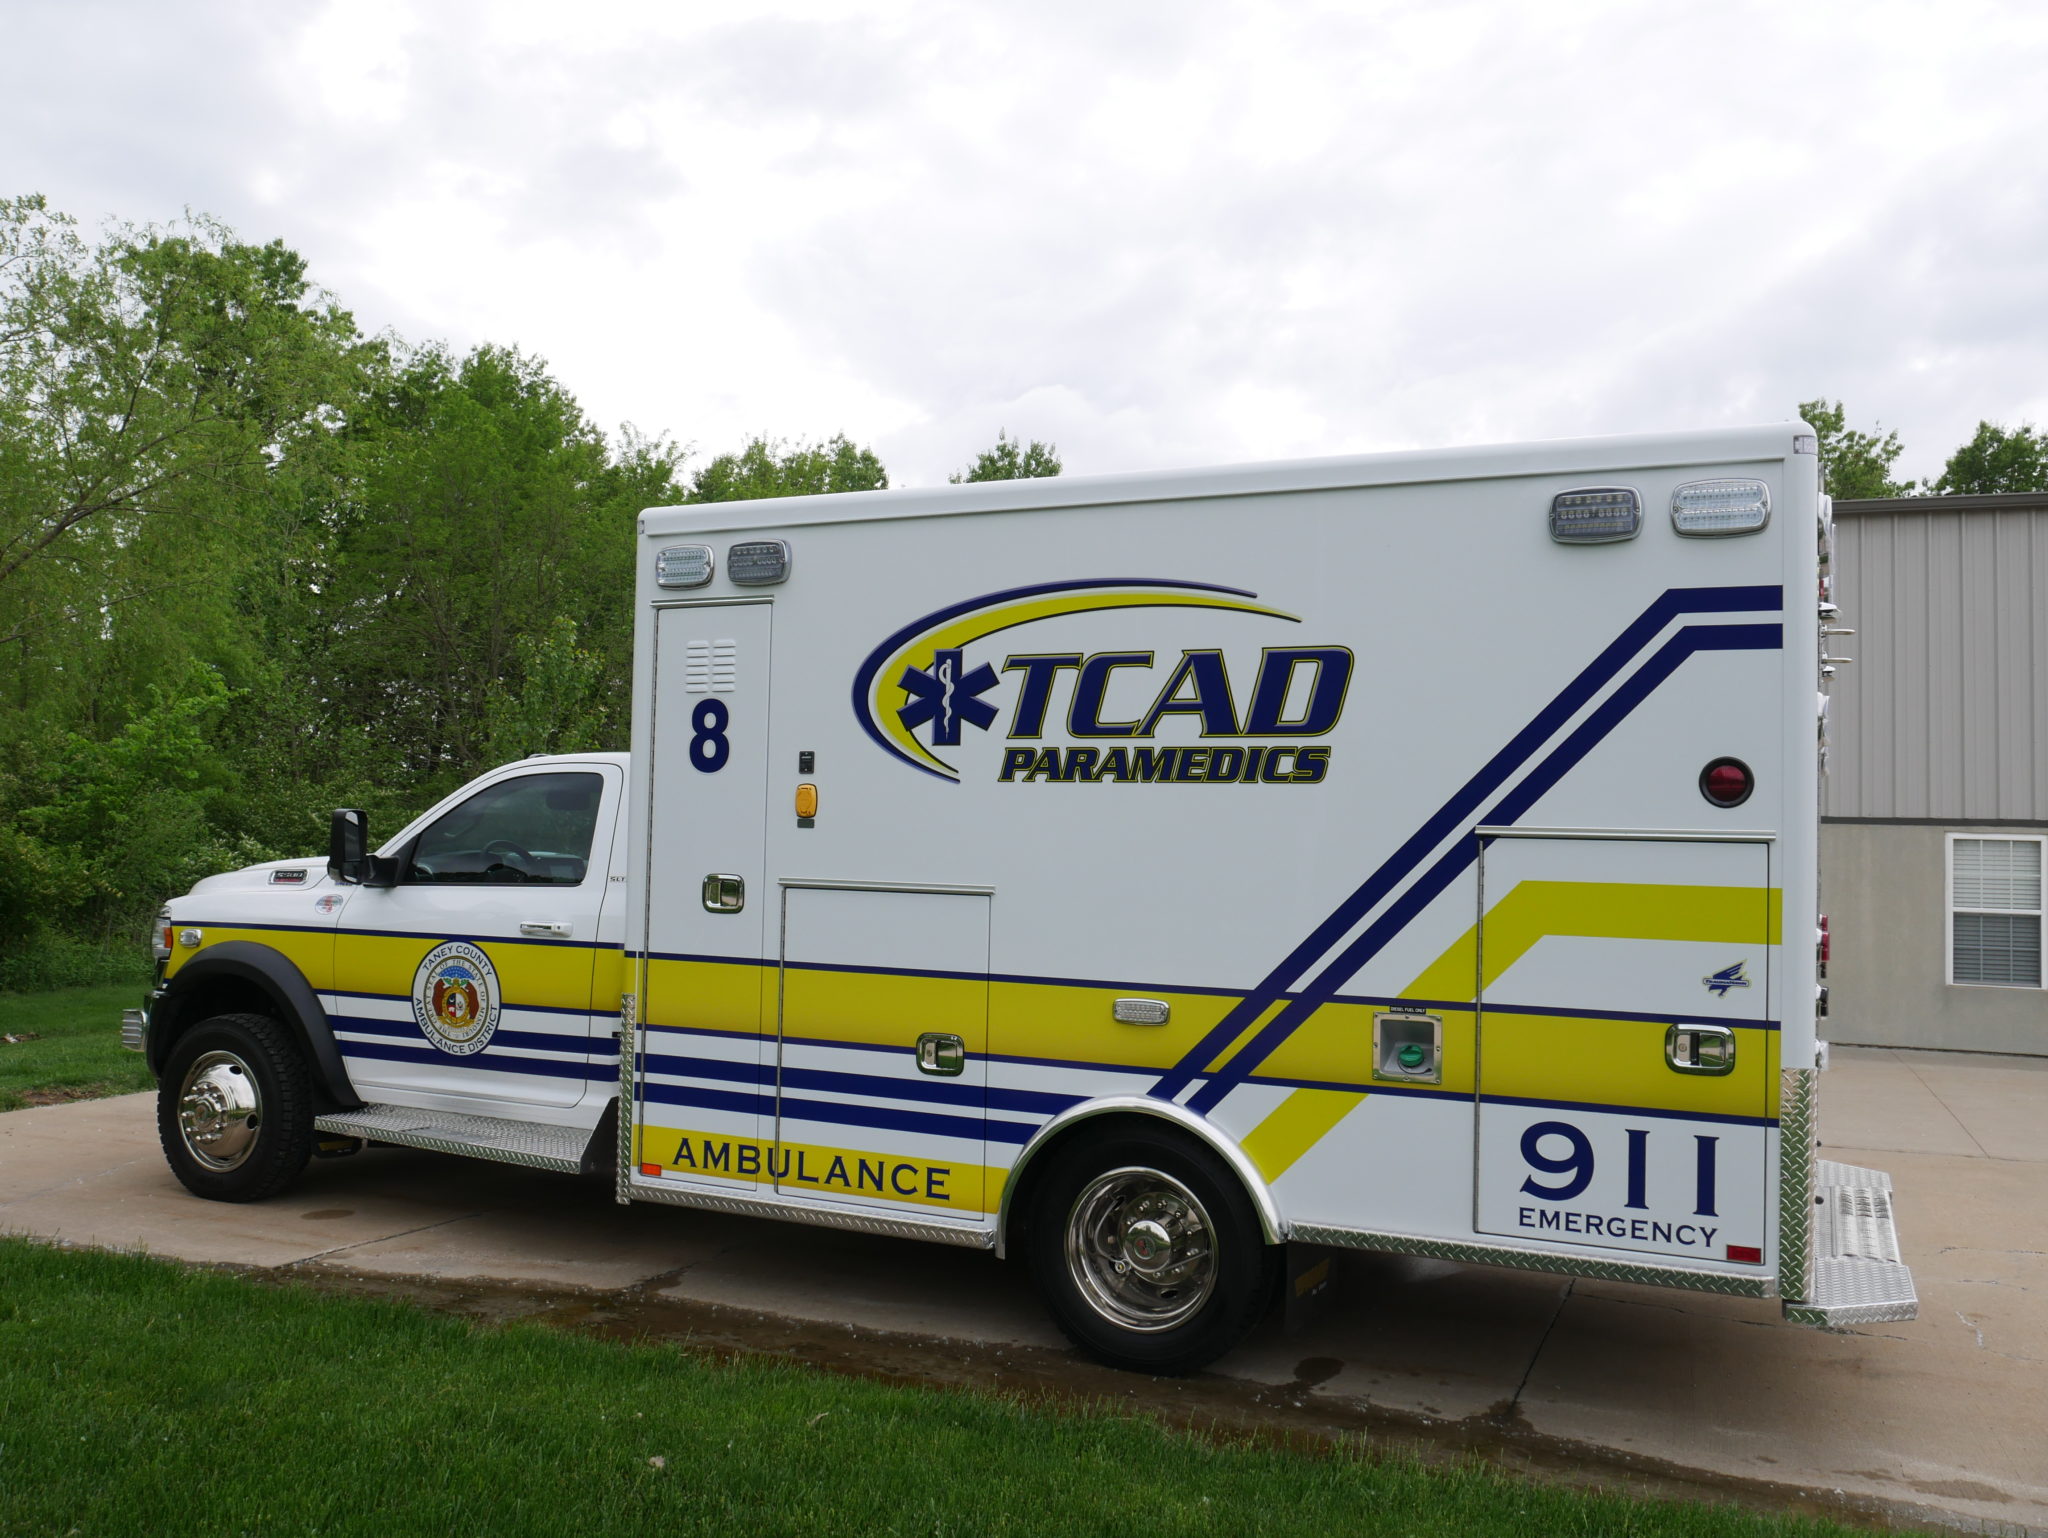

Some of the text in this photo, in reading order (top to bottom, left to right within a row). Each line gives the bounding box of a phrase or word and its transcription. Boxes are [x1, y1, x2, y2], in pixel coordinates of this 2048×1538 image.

[1001, 645, 1354, 739] TCAD
[689, 698, 730, 773] 8
[998, 746, 1331, 783] PARAMEDICS
[422, 945, 492, 976] TANEY COUNTY
[415, 997, 498, 1054] AMBULANCE DISTRICT
[672, 1137, 950, 1201] AMBULANCE
[1519, 1121, 1720, 1218] 911
[1519, 1206, 1719, 1248] EMERGENCY
